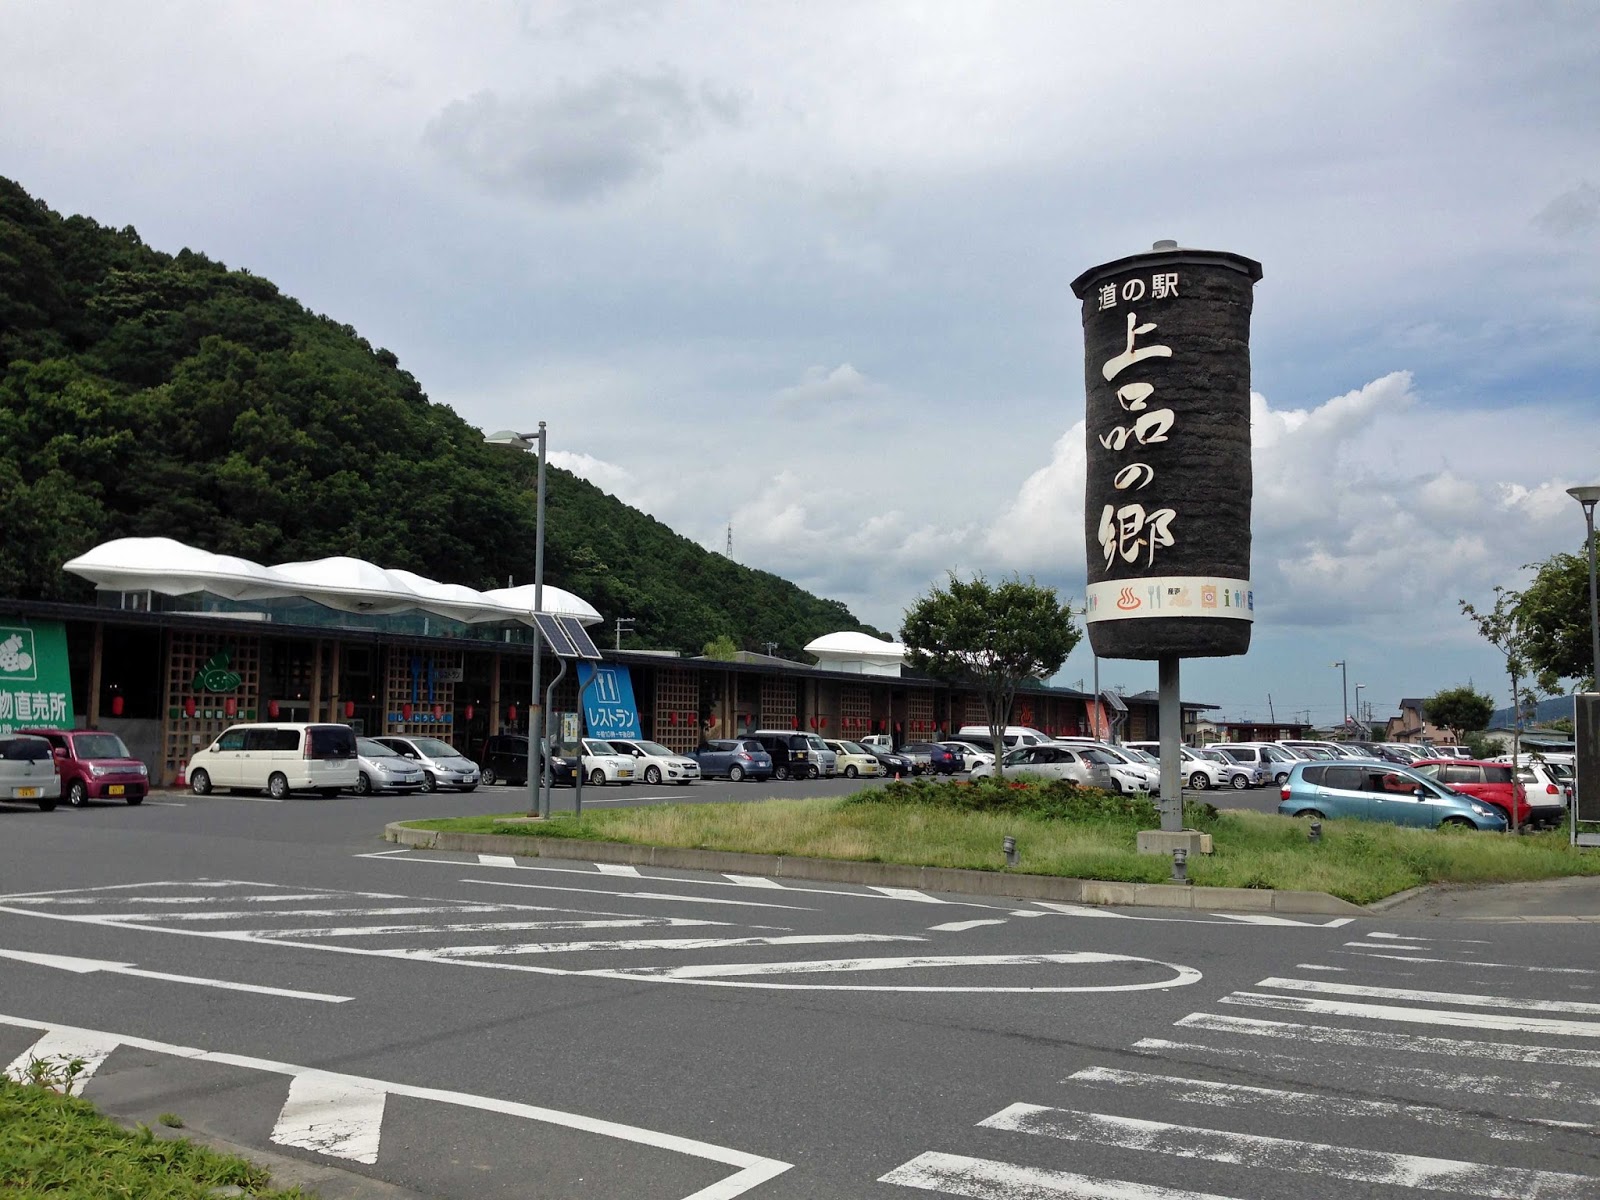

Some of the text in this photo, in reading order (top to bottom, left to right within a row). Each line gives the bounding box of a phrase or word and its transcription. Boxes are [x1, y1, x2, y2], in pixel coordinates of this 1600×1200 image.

[1098, 272, 1179, 311] 道の駅
[1098, 312, 1177, 572] 上品の郷
[398, 713, 444, 722] レトラン
[588, 707, 634, 728] レストラン
